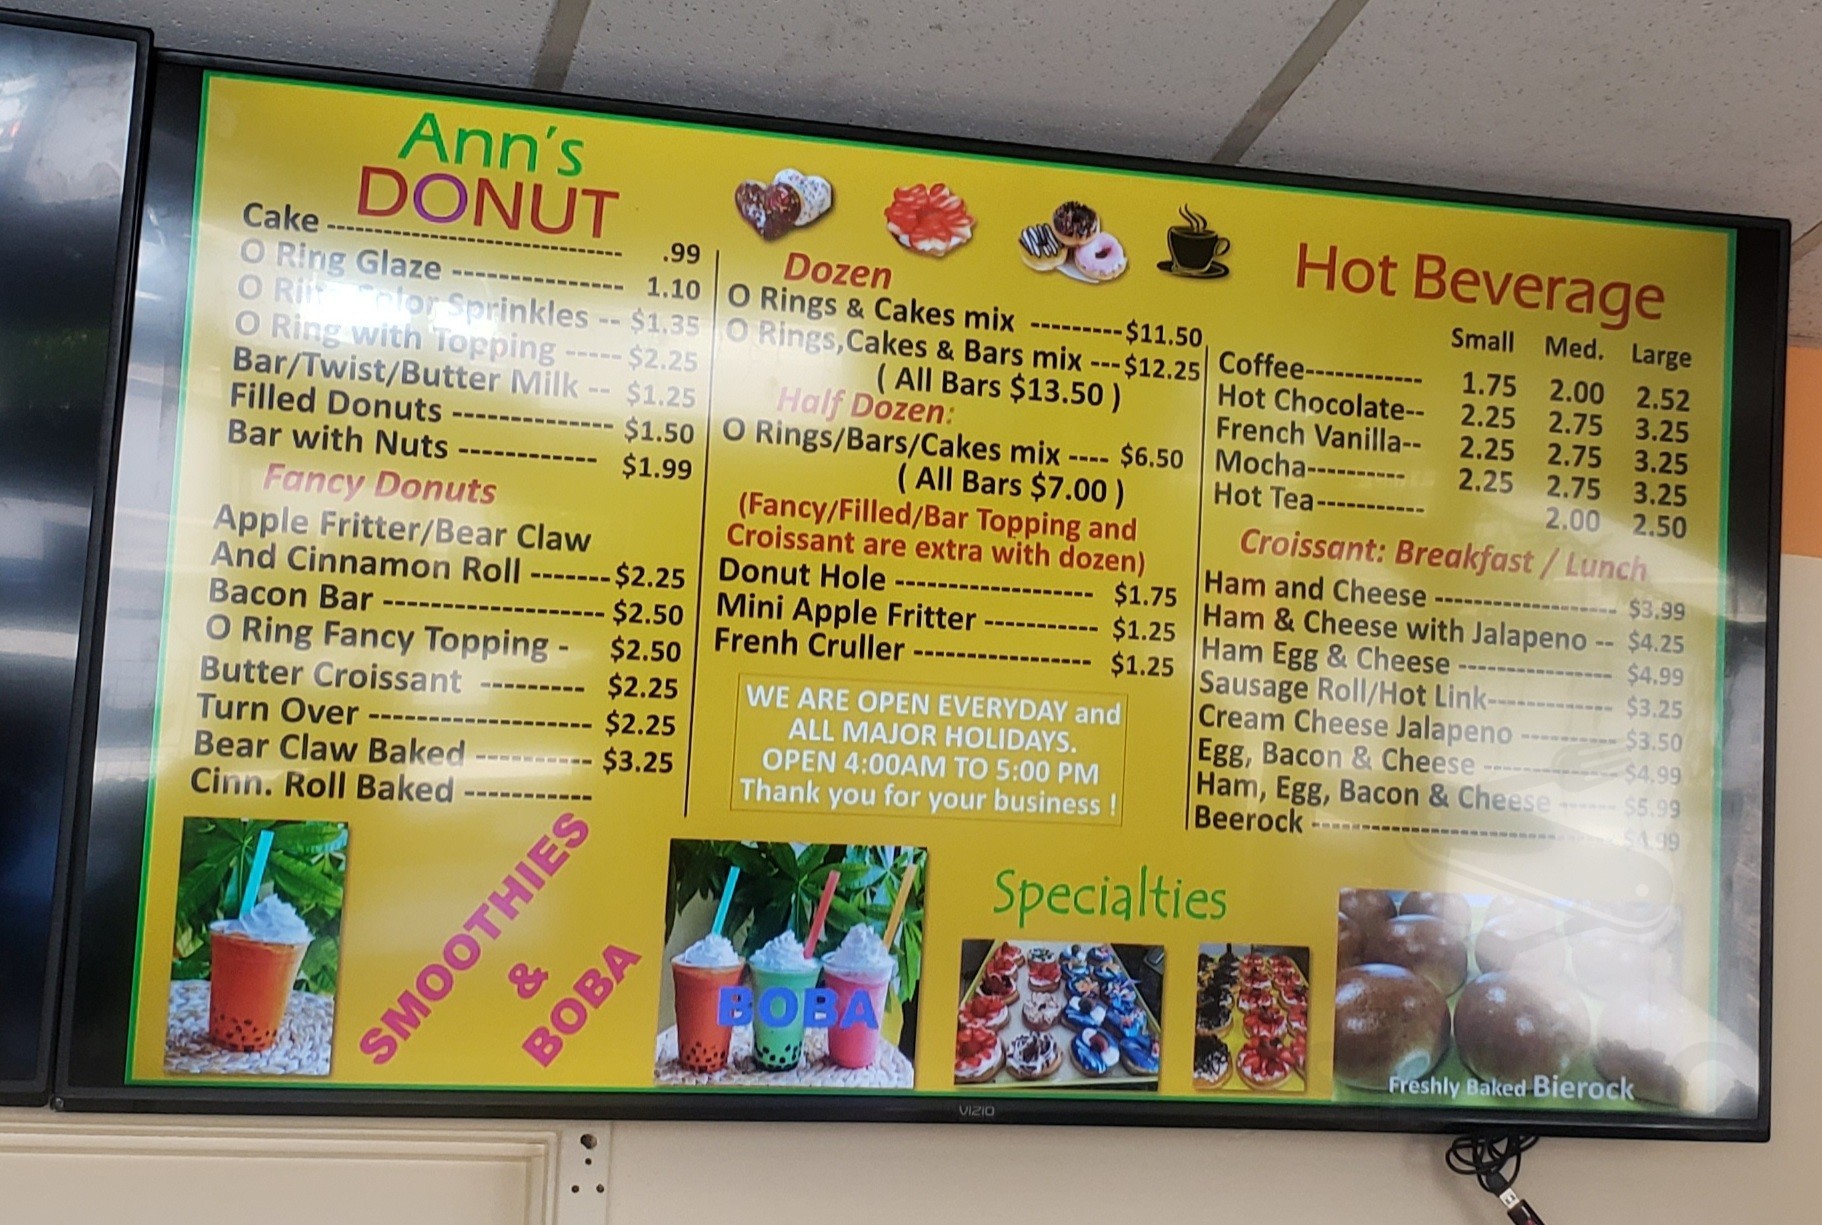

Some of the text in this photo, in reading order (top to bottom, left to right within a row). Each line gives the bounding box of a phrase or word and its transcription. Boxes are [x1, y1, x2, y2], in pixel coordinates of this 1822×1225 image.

[398, 112, 584, 177] Ann's
[357, 166, 620, 239] DONUT
[243, 202, 700, 264] Cake .99
[277, 241, 701, 300] Ring Glaze 1.10
[783, 252, 893, 290] Dozen
[1296, 242, 1666, 331] Hot Beverage
[352, 322, 422, 350] with
[760, 287, 1203, 348] Rings Cakes mix $11.50
[964, 340, 1201, 382] Bars mix $12.25
[1451, 326, 1692, 371] Small Med. Large
[233, 346, 696, 409] Bar/Twist/Butter Milk $1.25
[894, 367, 1102, 407] All Bars $13.50
[1462, 371, 1691, 412] 1.75 2.00 2.52
[230, 382, 694, 445] Filled Donuts $1.50
[1218, 384, 1690, 444] Hot 2.25 2.75 3.25
[228, 419, 692, 481] Bar with Nuts $1.99
[756, 420, 1184, 471] Rings/Bars/Cakes mix $6.50
[1216, 417, 1688, 476] French 2.25 2.75 3.25
[264, 462, 497, 505] Fancy Donuts
[915, 466, 1108, 503] All Bars $7.00
[1458, 468, 1688, 508] 2.25 2.75 3.25
[213, 503, 592, 553] Apple Fritter/Bear Claw
[976, 507, 1137, 542] Topping and
[1214, 482, 1688, 539] Hot 2.00 2.50
[210, 541, 685, 590] And Cinnamon Roll $2.25
[727, 523, 1051, 569] Croissant are extra with
[1394, 539, 1648, 583] Breakfast Lunch
[209, 578, 684, 628] Bacon Bar $2.50
[718, 556, 1177, 608] Donut Hole $1.75
[1204, 570, 1685, 622] Ham and Cheese $3.99
[242, 616, 681, 664] Ring Fancy Topping $2.50
[716, 592, 1176, 643] Mini Apple Fritter $1.25
[1203, 605, 1685, 655] Ham Cheese with Jalapeno $4.25
[714, 626, 1174, 679] Frenh Cruller $1.25
[1202, 637, 1684, 688] Ham Egg Cheese $4.99
[200, 655, 678, 700] Butter Croissant $2.25
[1199, 670, 1683, 721] Sausage $3.25
[196, 693, 676, 737] Turn Over $2.25
[746, 684, 1121, 726] WE ARE OPEN EVERYDAY and
[1198, 704, 1513, 748] Cream Cheese Jalapeno
[194, 730, 673, 775] Bear Claw Baked $3.25
[789, 718, 937, 747] ALL MAJOR
[762, 747, 1100, 786] OPEN 4:00AM TO 5:00 PM
[1262, 741, 1475, 776] Bacon Cheese
[191, 767, 454, 804] Cinn. Roll Baked
[740, 778, 1100, 817] Thank you for your business
[1339, 779, 1419, 808] Bacon
[1194, 805, 1304, 836] Beerock
[993, 864, 1227, 929] Specialties
[359, 812, 590, 1064] SMOOTHIES
[521, 944, 642, 1068] BOBA
[717, 985, 882, 1031] BOBA
[959, 1104, 995, 1117] VIZIO
[1389, 1074, 1634, 1101] Freshly Baked Bierock
